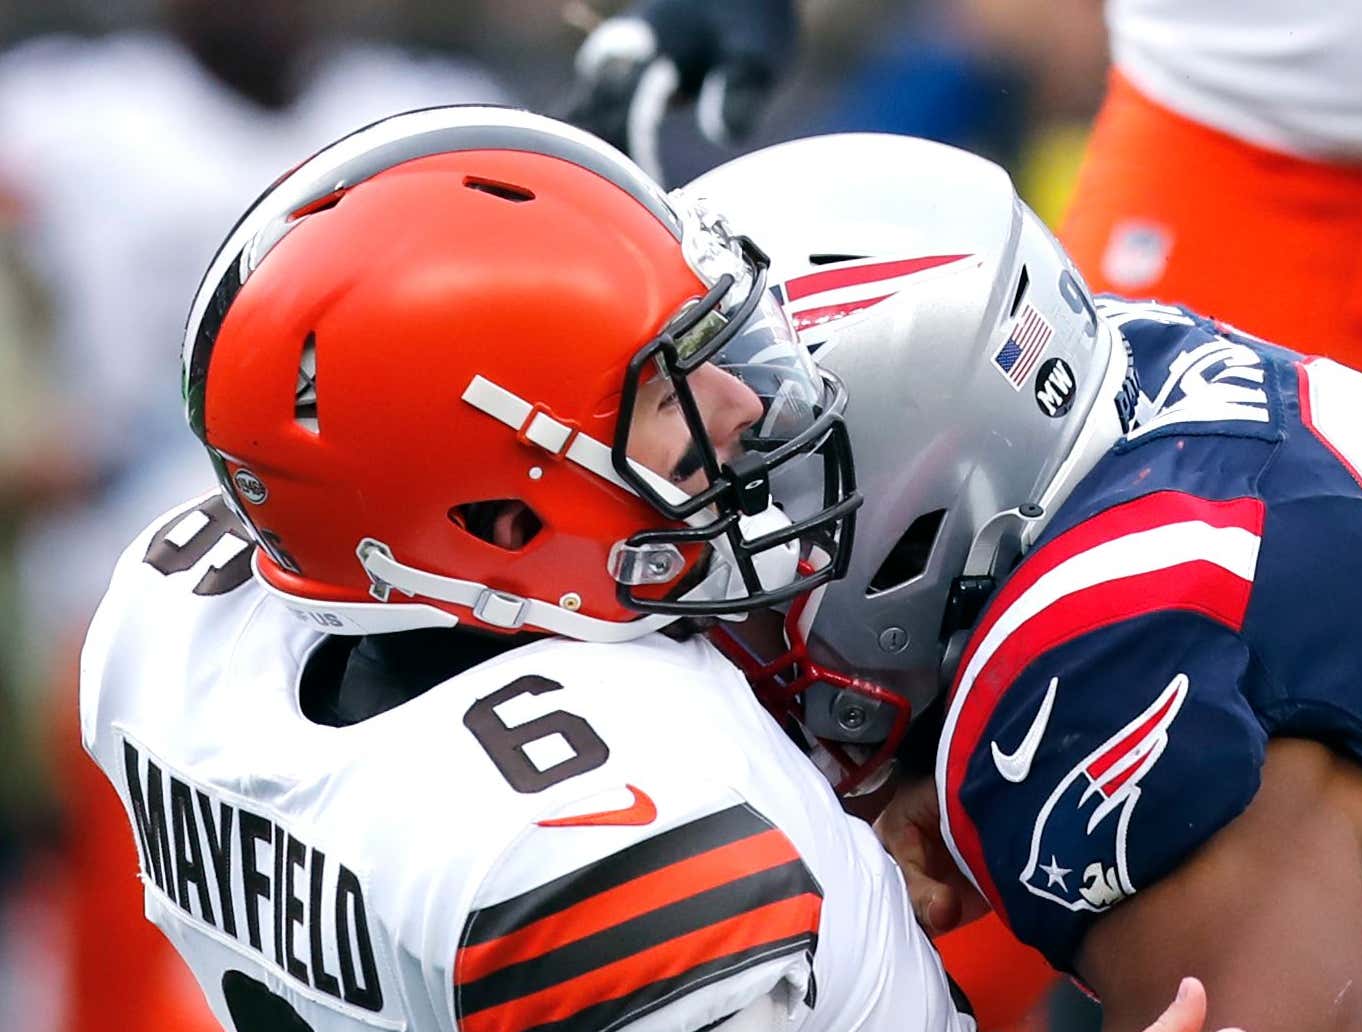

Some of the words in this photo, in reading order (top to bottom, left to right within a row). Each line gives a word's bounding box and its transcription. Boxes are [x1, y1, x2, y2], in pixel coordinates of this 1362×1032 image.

[1037, 359, 1073, 416] MW
[462, 674, 610, 794] 6
[123, 738, 384, 1015] MAYFIELD
